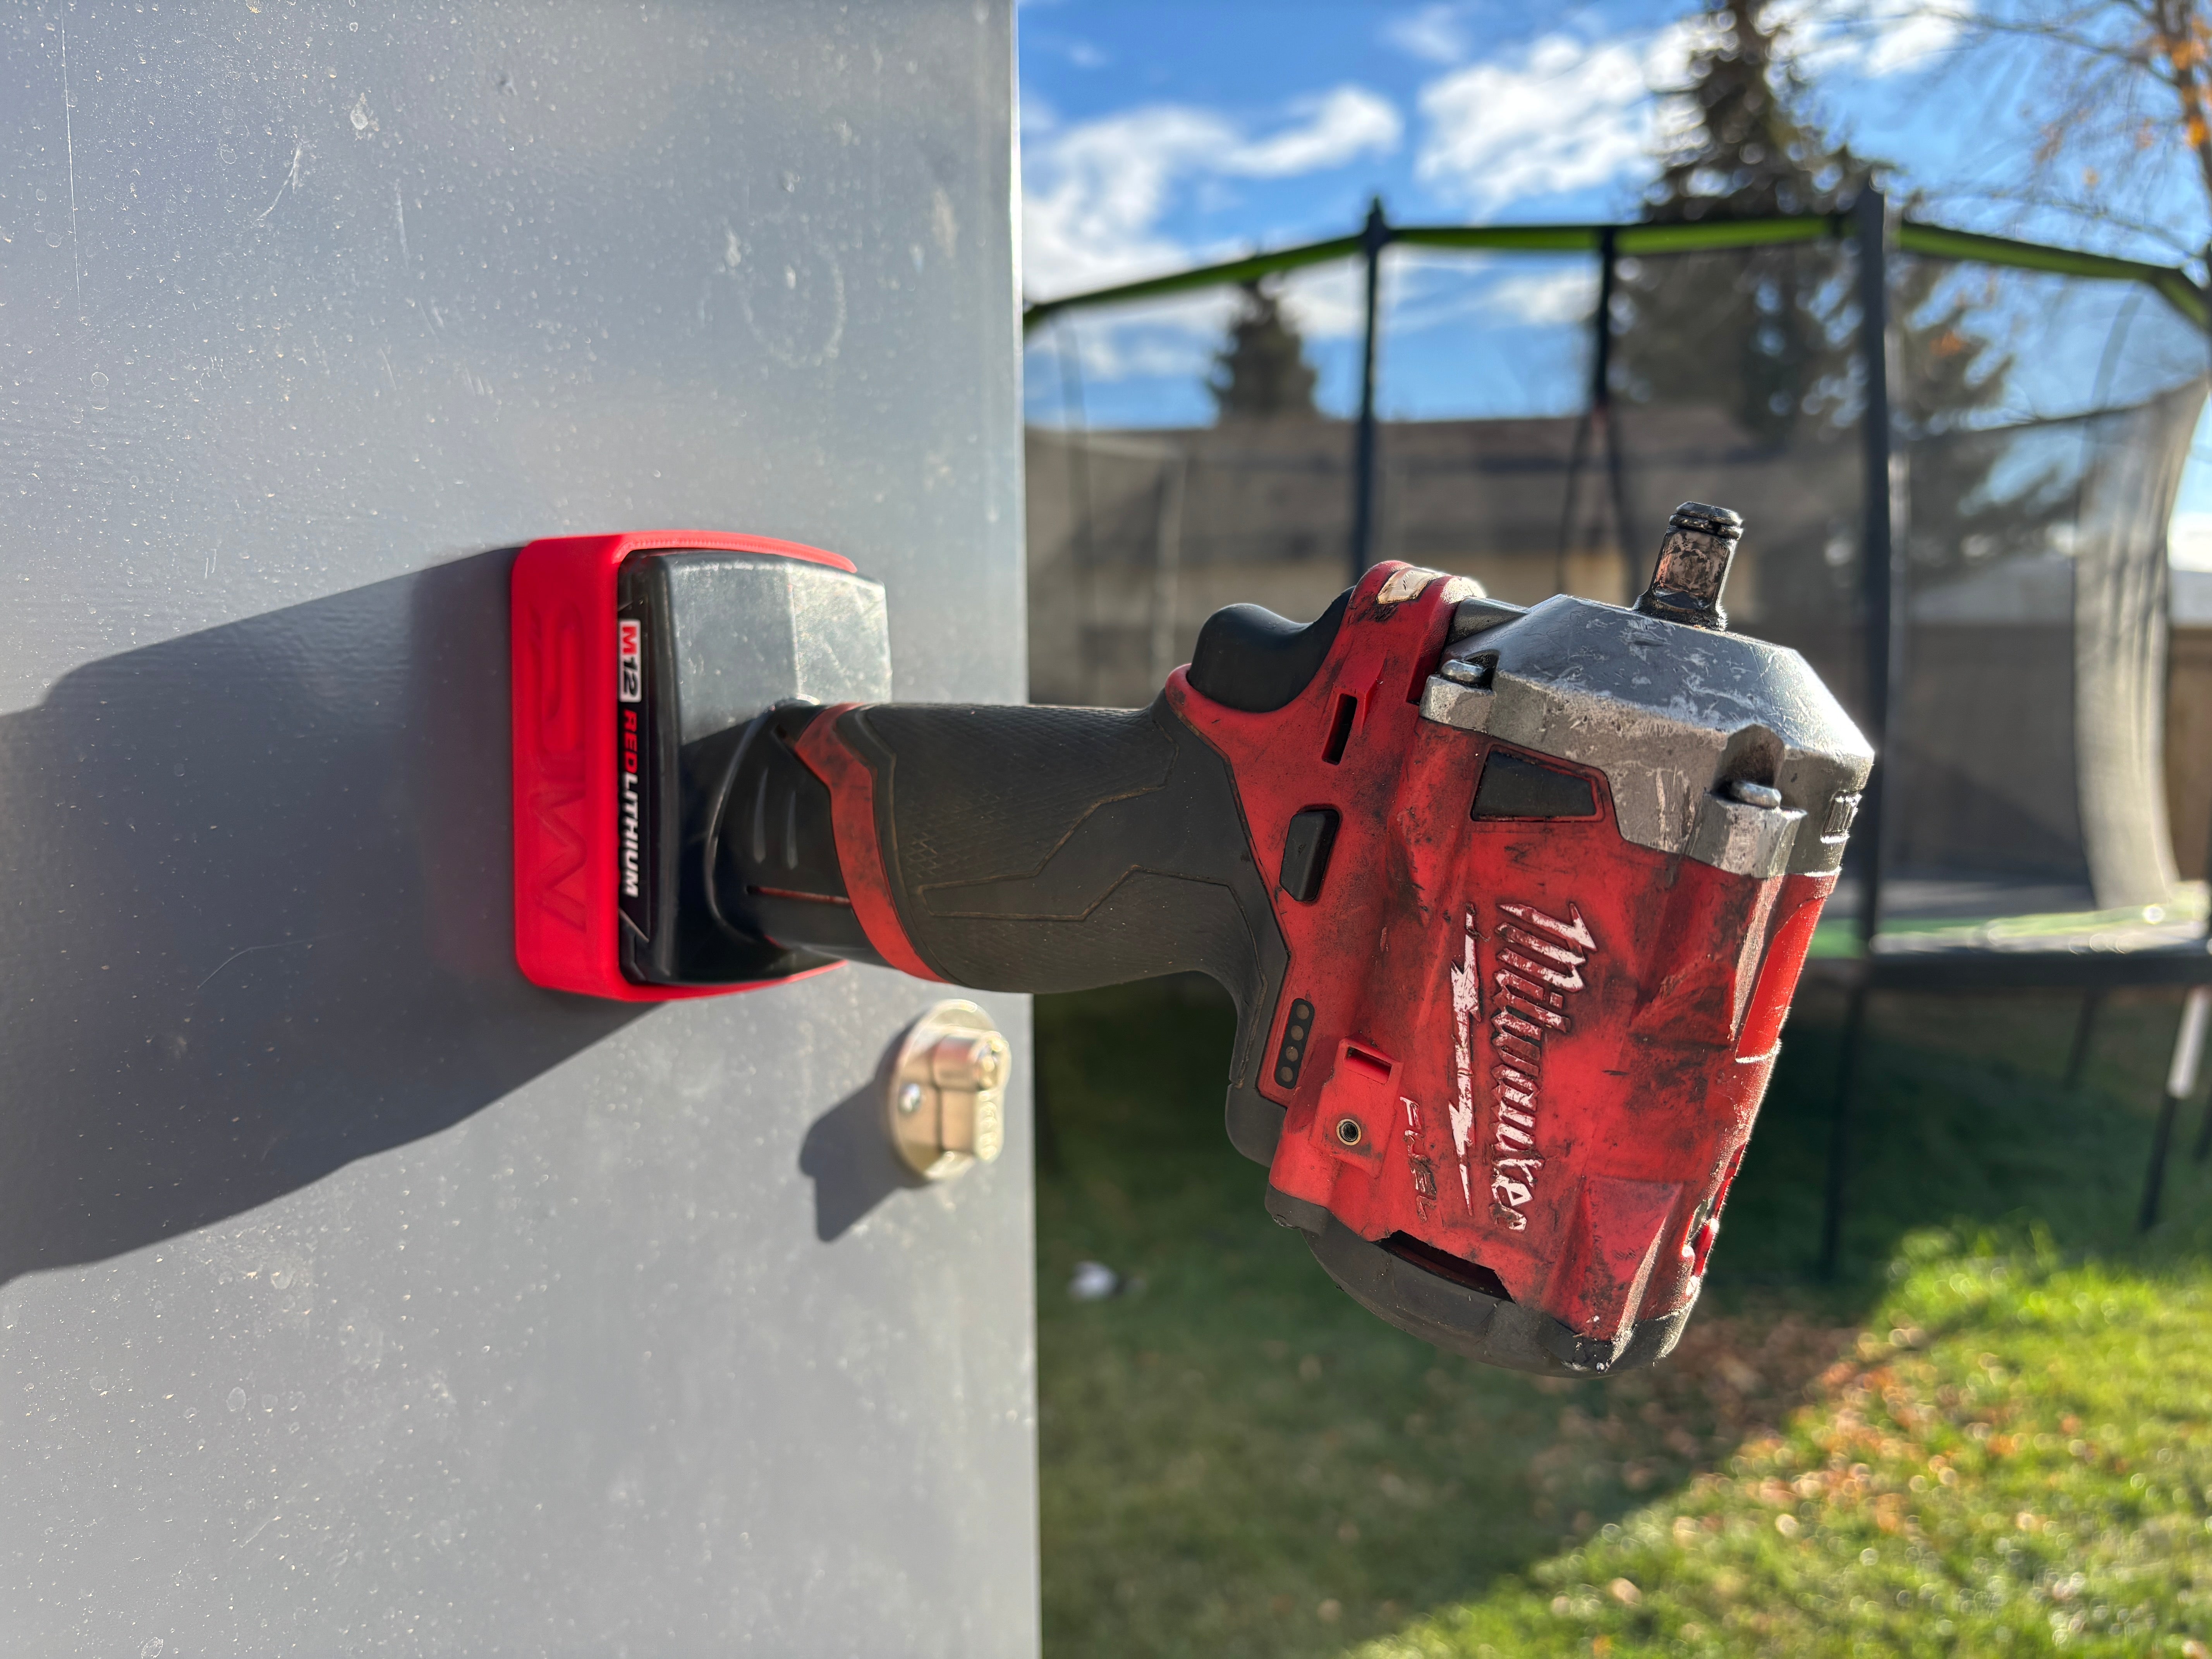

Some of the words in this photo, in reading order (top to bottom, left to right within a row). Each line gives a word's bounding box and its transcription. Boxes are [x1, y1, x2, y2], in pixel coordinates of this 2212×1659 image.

[623, 626, 638, 696] M12
[623, 709, 639, 898] REDLITHIUM
[1491, 902, 1598, 1233] Milwaukee
[1399, 1096, 1437, 1223] FUEL
